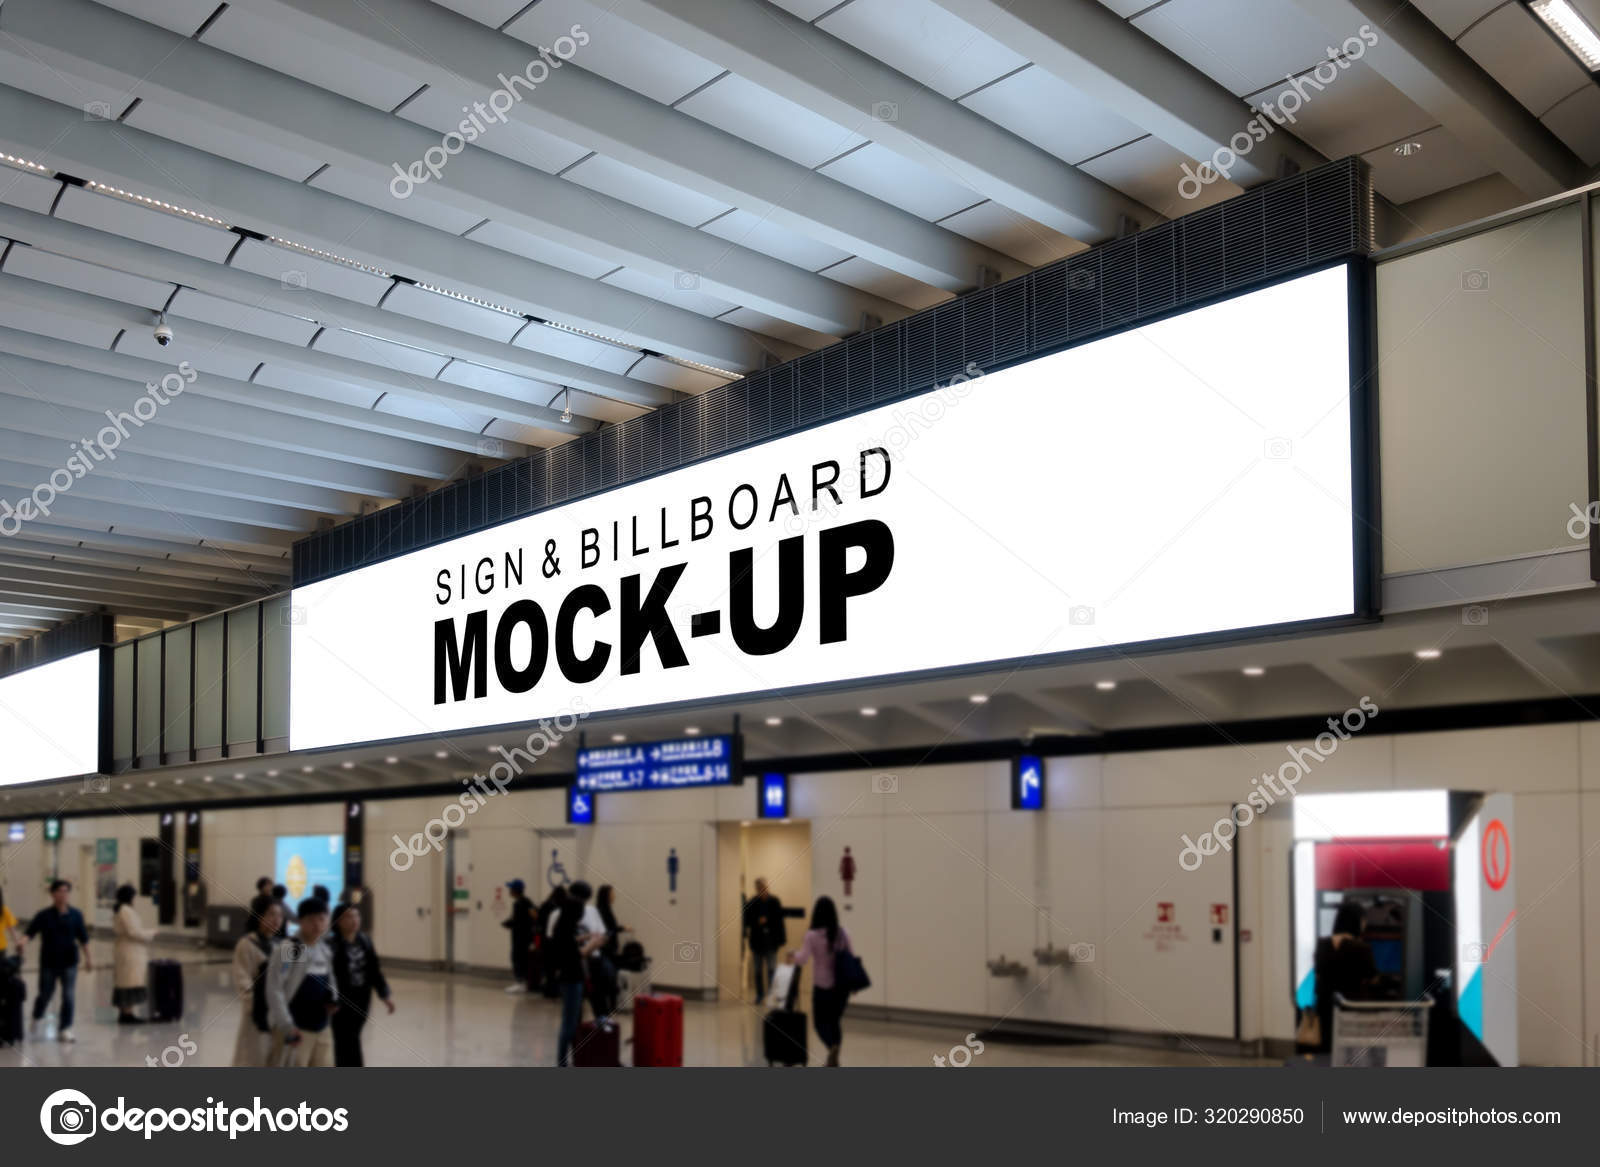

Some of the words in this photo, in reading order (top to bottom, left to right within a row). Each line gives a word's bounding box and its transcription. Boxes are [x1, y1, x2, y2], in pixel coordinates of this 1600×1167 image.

[434, 519, 895, 705] MOCK-UP
[436, 548, 523, 605] SIGN
[541, 539, 561, 578] &
[581, 447, 892, 569] BILLBOARD
